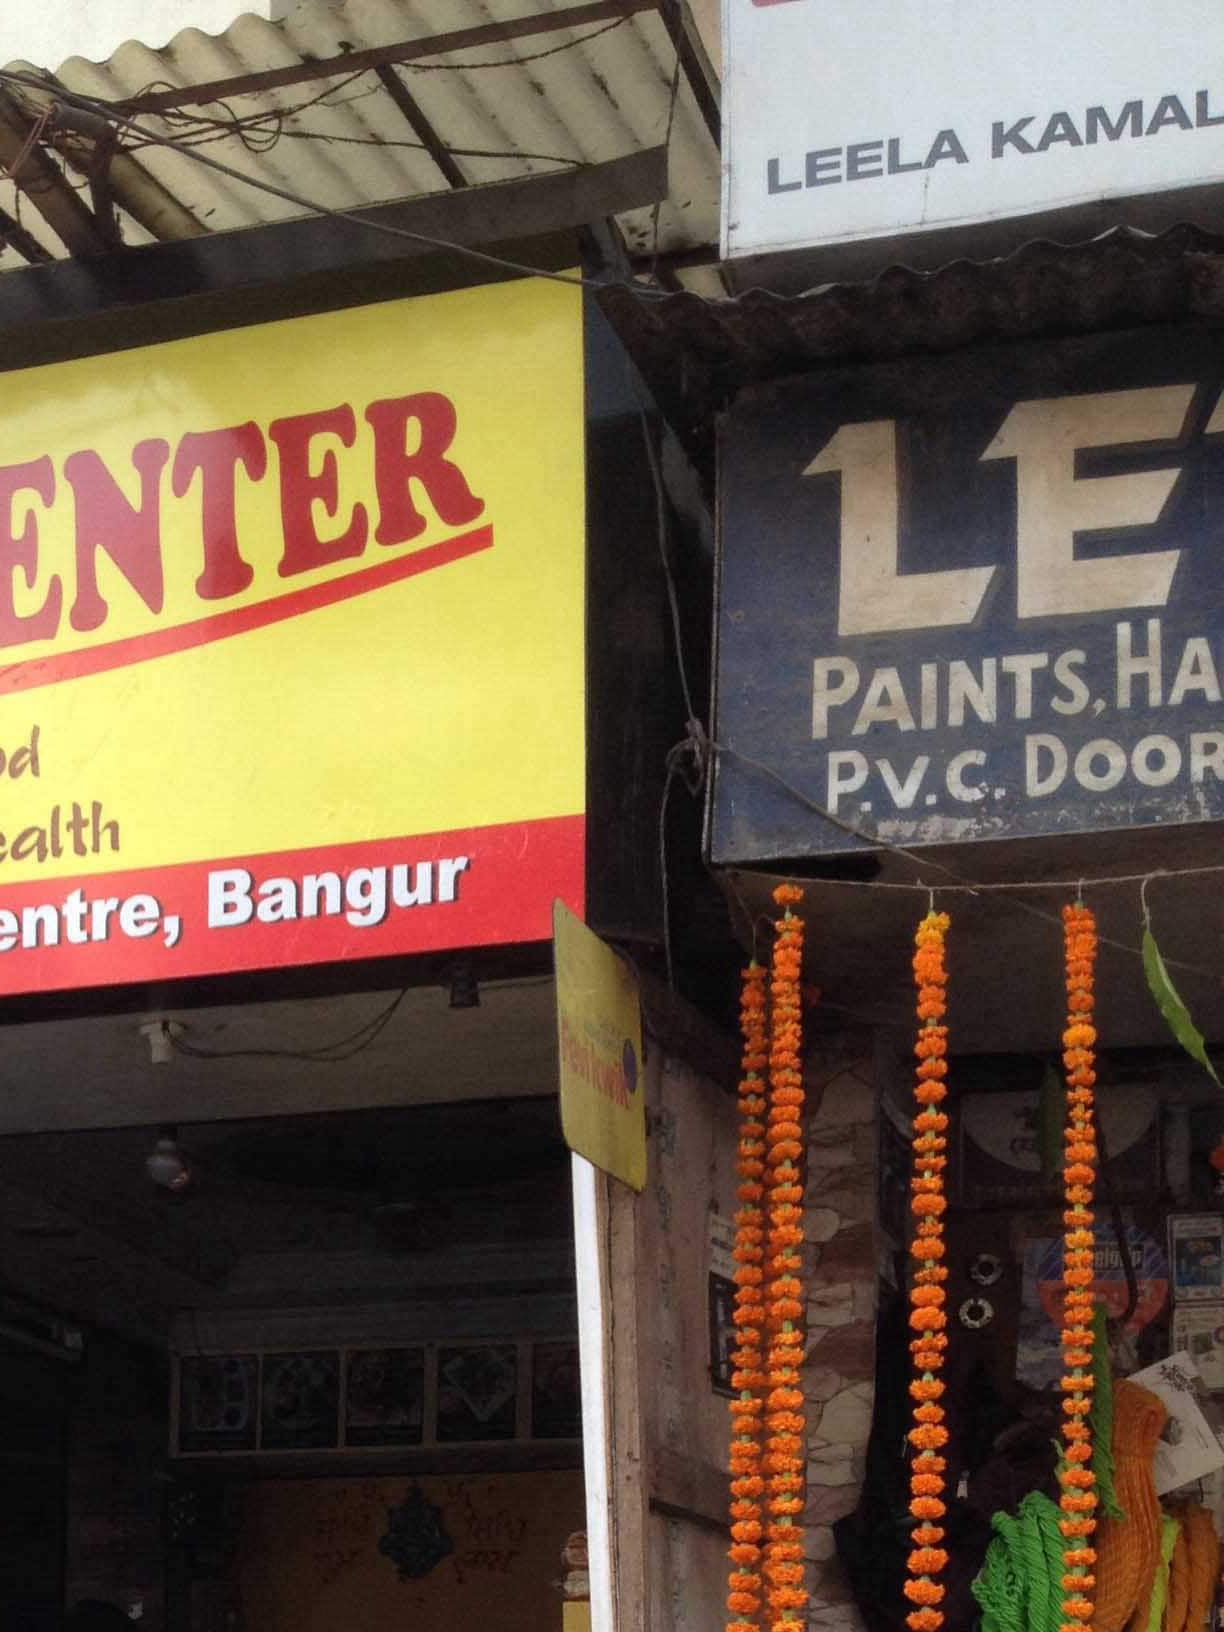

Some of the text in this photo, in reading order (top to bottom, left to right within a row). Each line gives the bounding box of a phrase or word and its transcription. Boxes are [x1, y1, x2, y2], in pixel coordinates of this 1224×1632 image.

[766, 87, 1224, 195] LEELA KAMAL
[800, 383, 1224, 636] LE
[826, 731, 1224, 815] P.V.C. DOOR
[207, 851, 470, 931] Bangur
